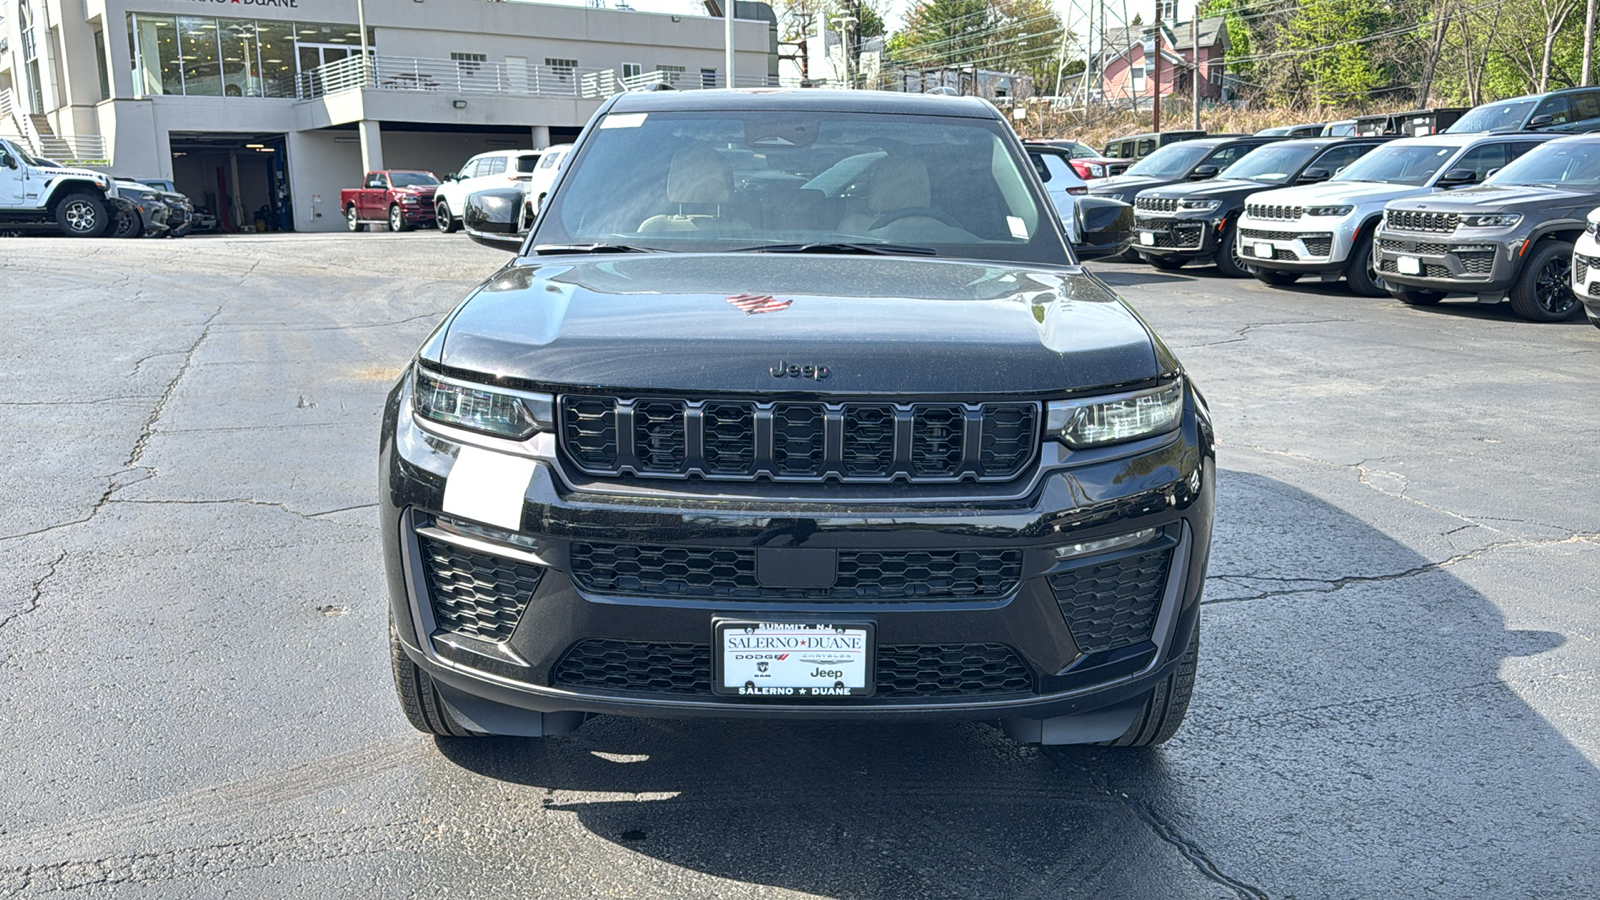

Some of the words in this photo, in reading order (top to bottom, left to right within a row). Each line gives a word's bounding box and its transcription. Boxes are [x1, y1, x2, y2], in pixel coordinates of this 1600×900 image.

[769, 360, 830, 381] Jeep
[728, 637, 799, 649] SALERNO
[808, 638, 862, 649] DUANE
[810, 667, 843, 680] Jeep
[739, 687, 794, 695] SALERNO
[811, 687, 851, 696] DUANE
